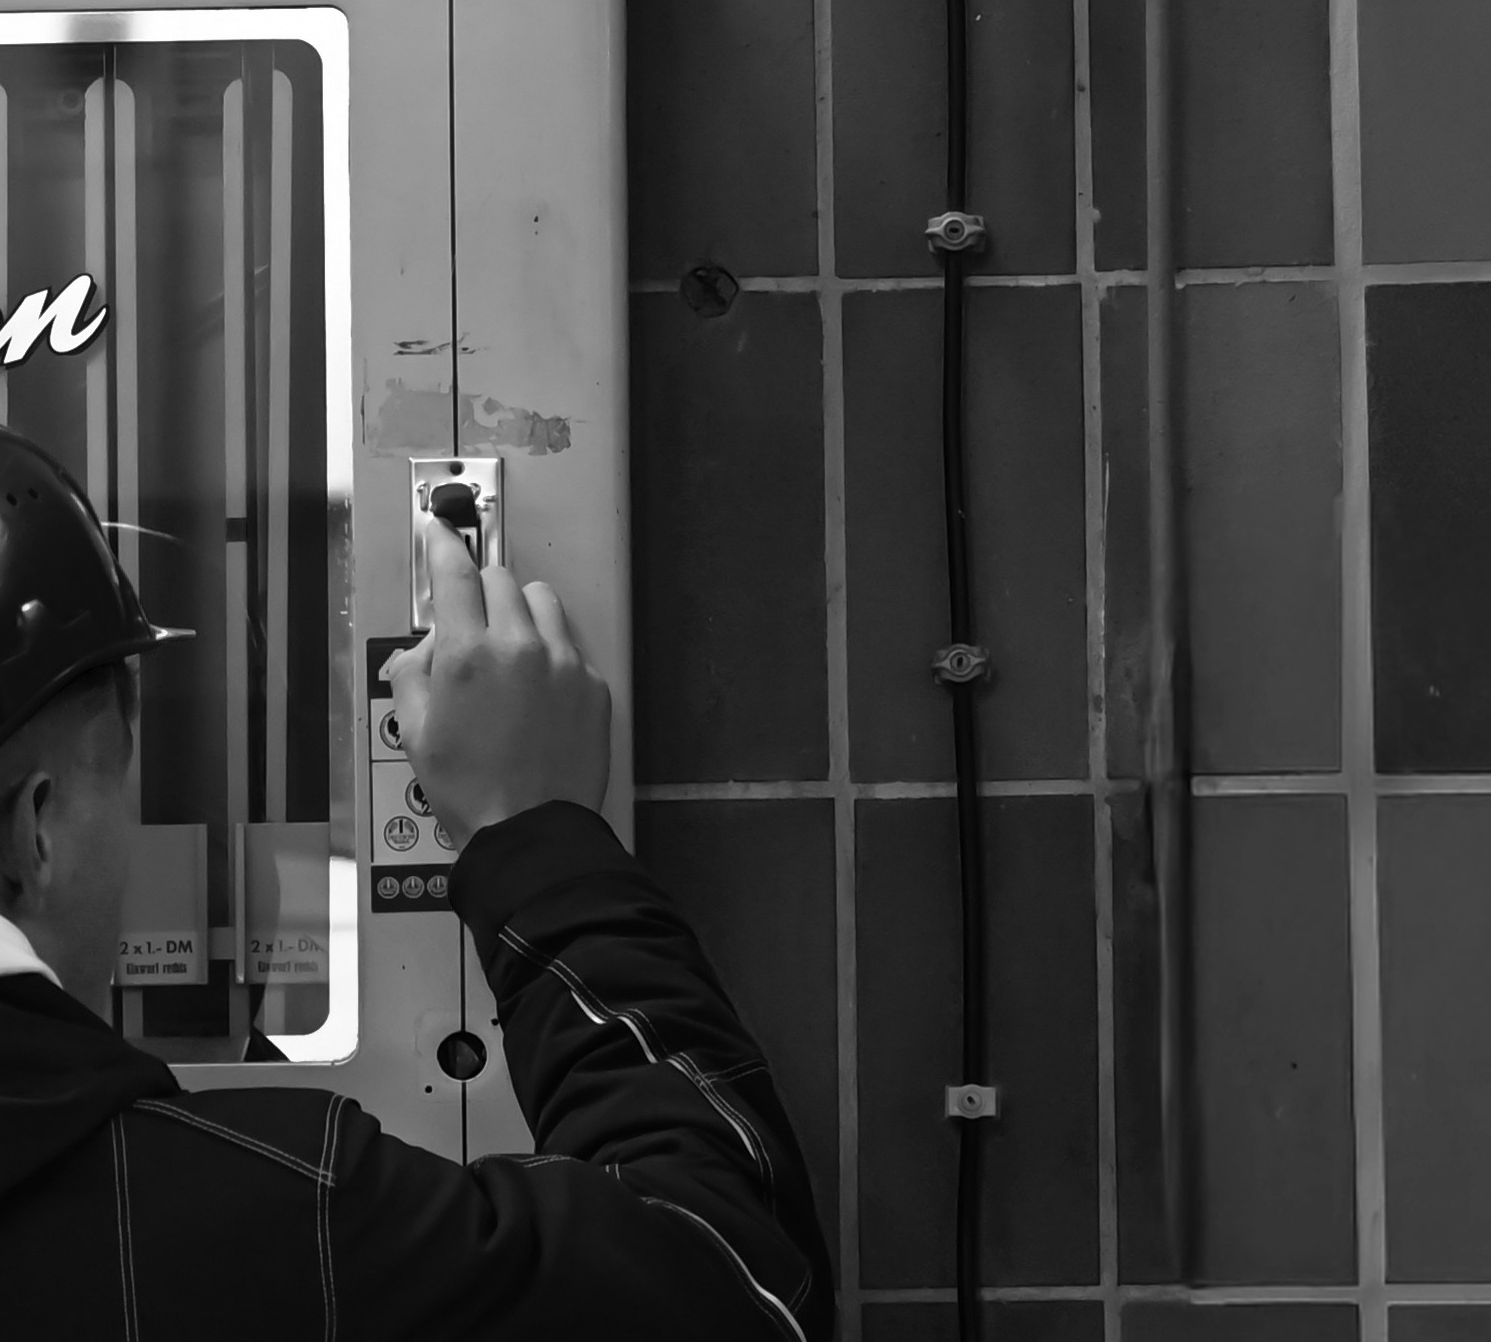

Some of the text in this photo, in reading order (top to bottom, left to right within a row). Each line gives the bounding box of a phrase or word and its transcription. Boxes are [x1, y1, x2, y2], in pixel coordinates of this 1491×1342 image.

[119, 941, 129, 955] 2
[133, 945, 143, 955] x
[166, 940, 193, 954] DM
[250, 939, 260, 953] 2
[265, 943, 274, 953] x
